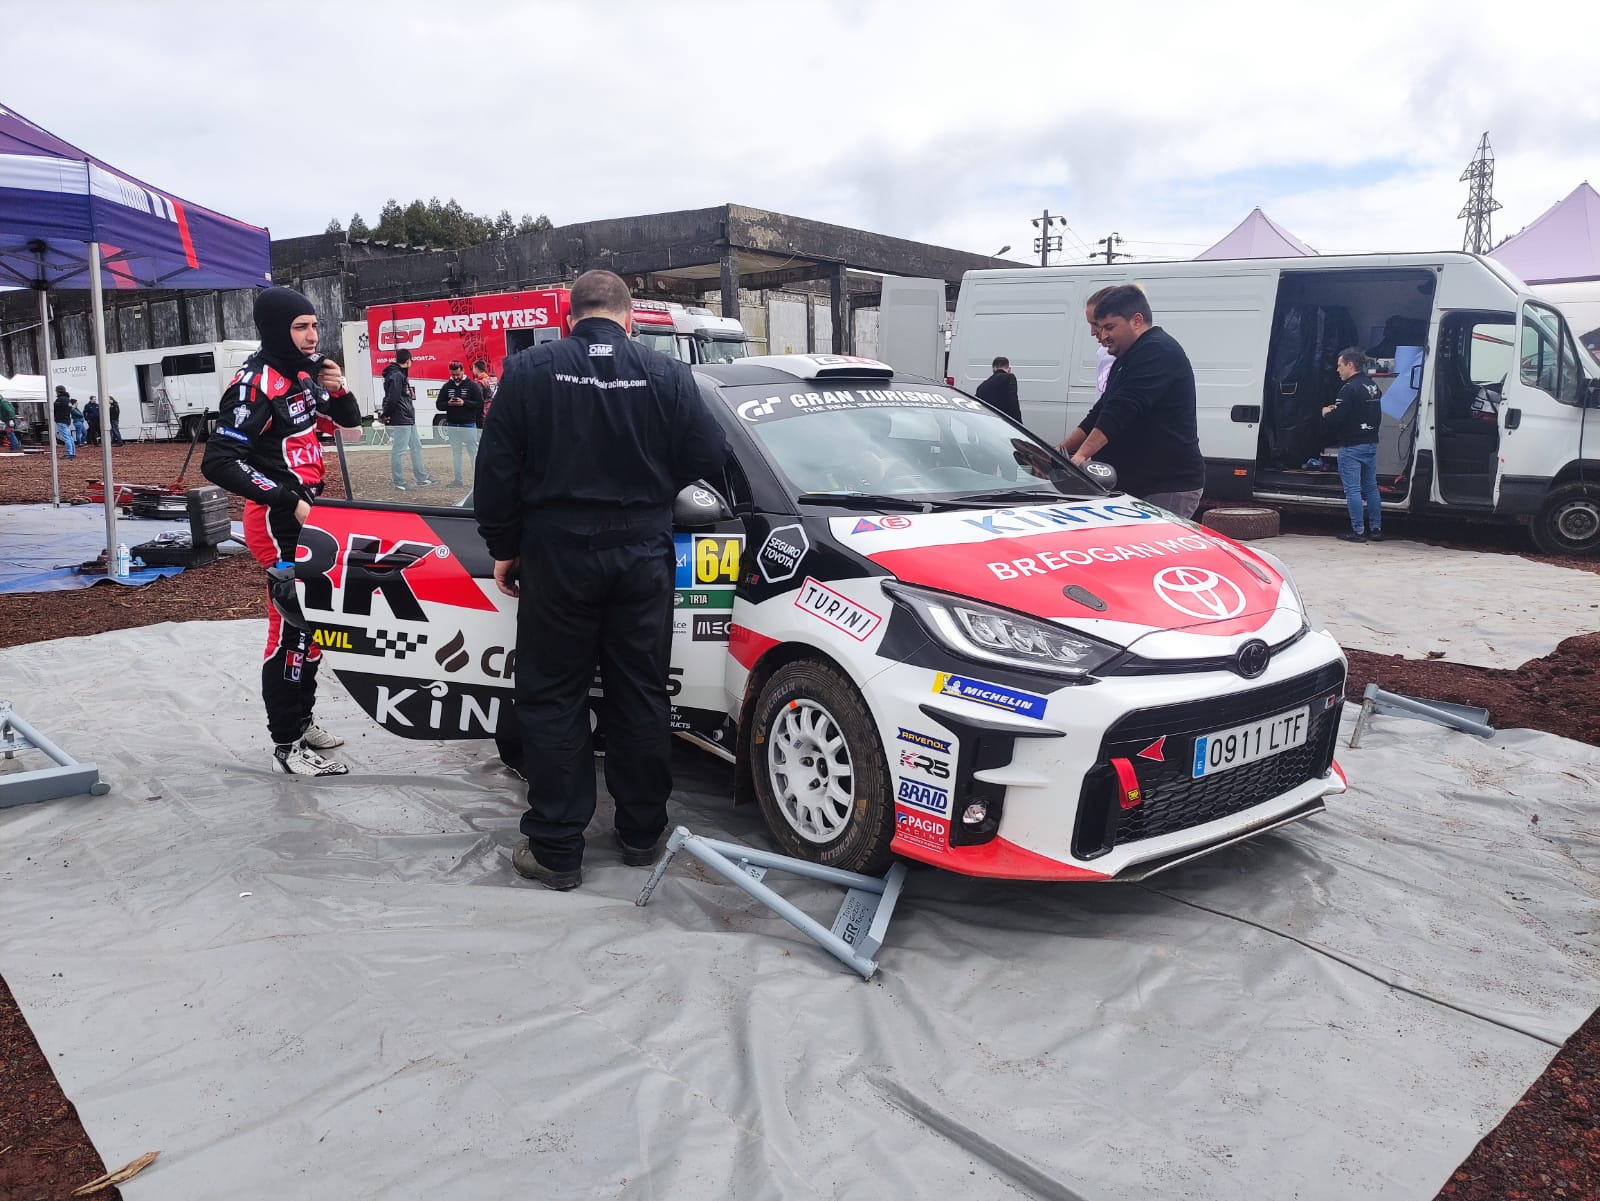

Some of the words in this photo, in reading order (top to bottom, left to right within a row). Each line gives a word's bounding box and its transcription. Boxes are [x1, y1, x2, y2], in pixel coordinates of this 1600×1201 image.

[433, 313, 486, 333] MRF
[488, 308, 548, 329] TYRES
[588, 346, 613, 355] OMP
[789, 390, 856, 408] GRAN
[856, 389, 949, 404] TURISMO
[764, 546, 795, 569] TOYOTA
[768, 537, 801, 559] SEGURO
[696, 538, 741, 583] 64
[986, 541, 1165, 581] BREOGAN
[804, 586, 871, 633] TURINI
[963, 686, 1033, 710] MICHELIN
[902, 732, 946, 750] RAVENOL
[1210, 726, 1262, 768] 0911
[1269, 713, 1305, 751] LTF
[898, 781, 948, 810] BRAID
[908, 815, 945, 835] PAGID
[842, 922, 859, 945] GR
